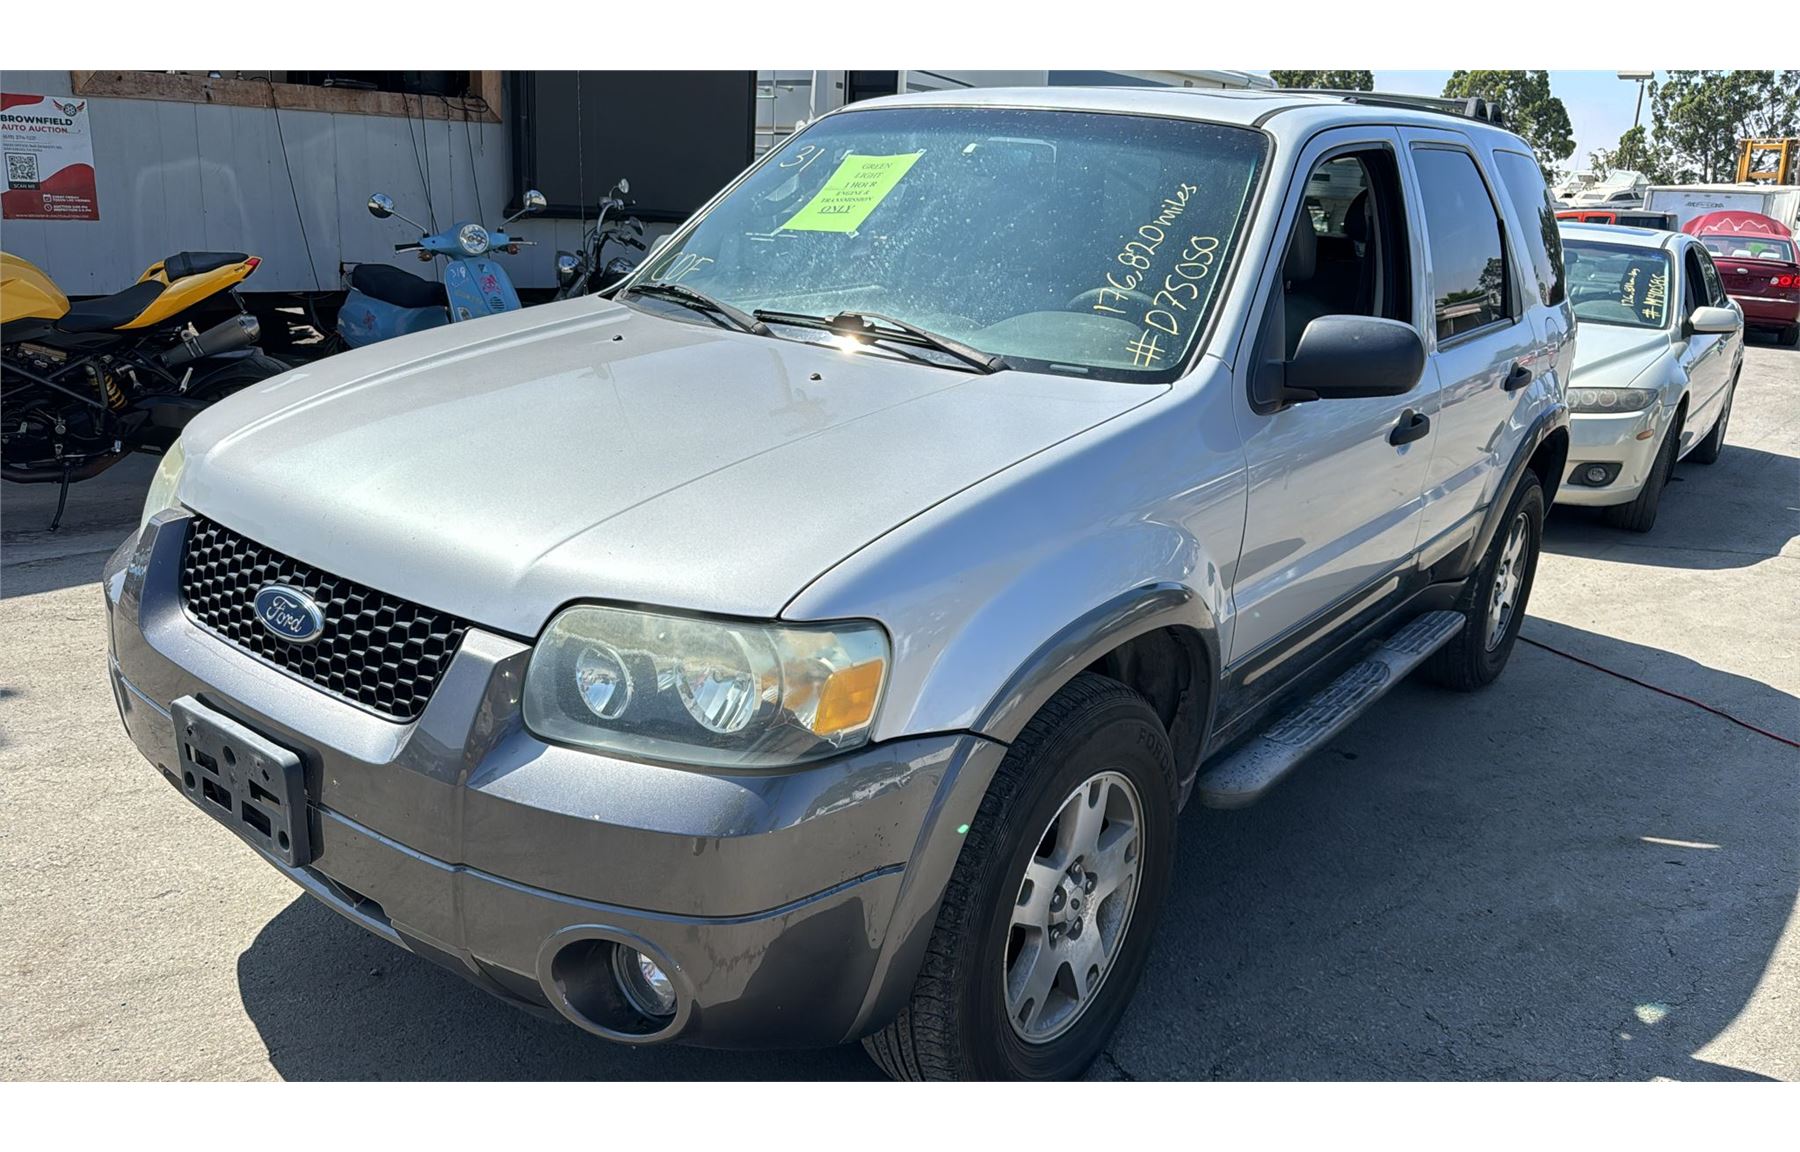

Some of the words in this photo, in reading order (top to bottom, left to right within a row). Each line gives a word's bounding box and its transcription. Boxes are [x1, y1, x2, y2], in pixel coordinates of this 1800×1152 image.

[0, 114, 73, 126] BROWNFIELD
[1, 123, 27, 132] AUTO
[29, 125, 68, 134] AUCTION
[779, 145, 825, 173] 31
[861, 162, 893, 170] GREEN
[851, 181, 878, 189] HOUR
[818, 205, 856, 214] ONLY
[266, 595, 305, 633] Ford
